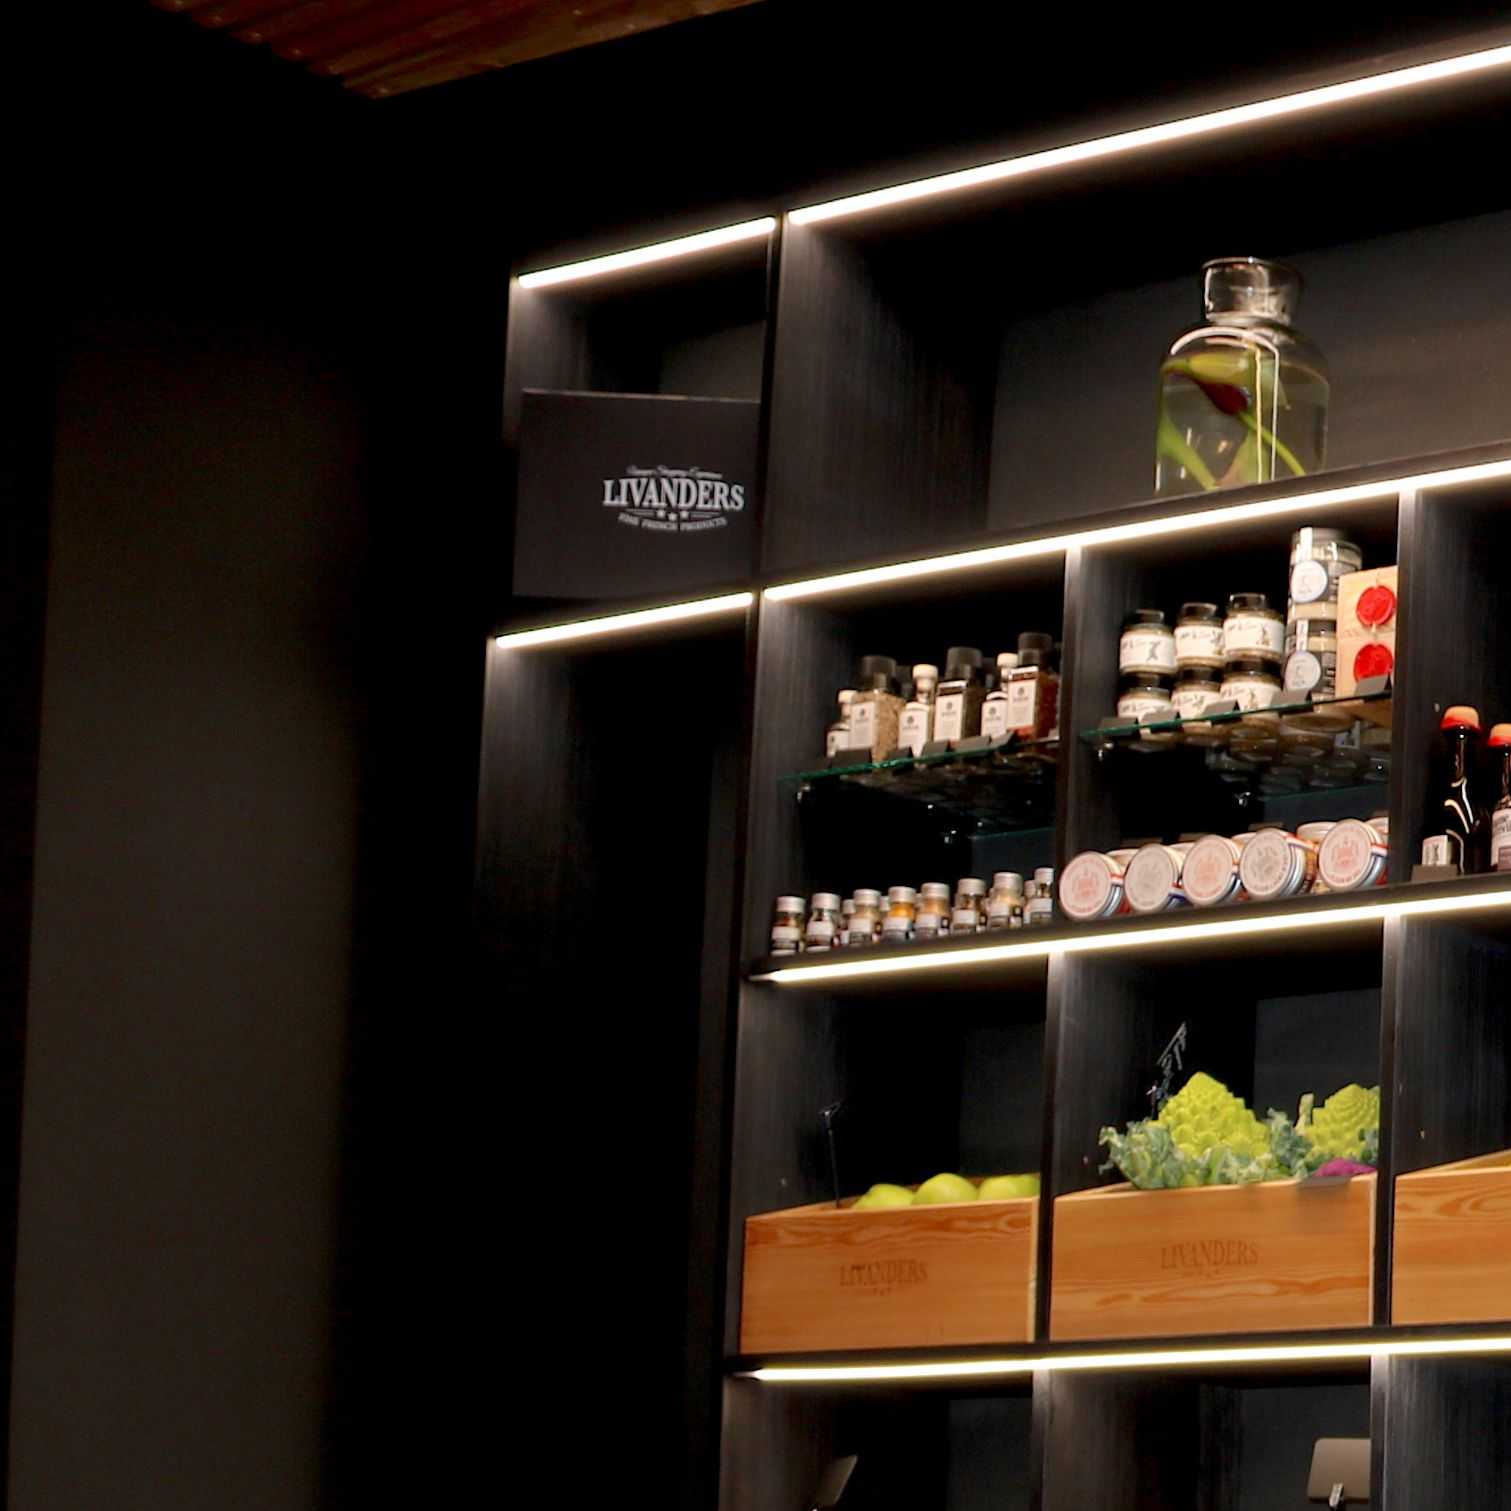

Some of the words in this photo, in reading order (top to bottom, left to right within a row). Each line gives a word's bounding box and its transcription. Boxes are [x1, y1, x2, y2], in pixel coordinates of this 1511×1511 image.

[603, 477, 745, 511] LIVANDERS
[1161, 1240, 1259, 1269] LIVANDERS
[840, 1260, 928, 1287] LIVANDERS
